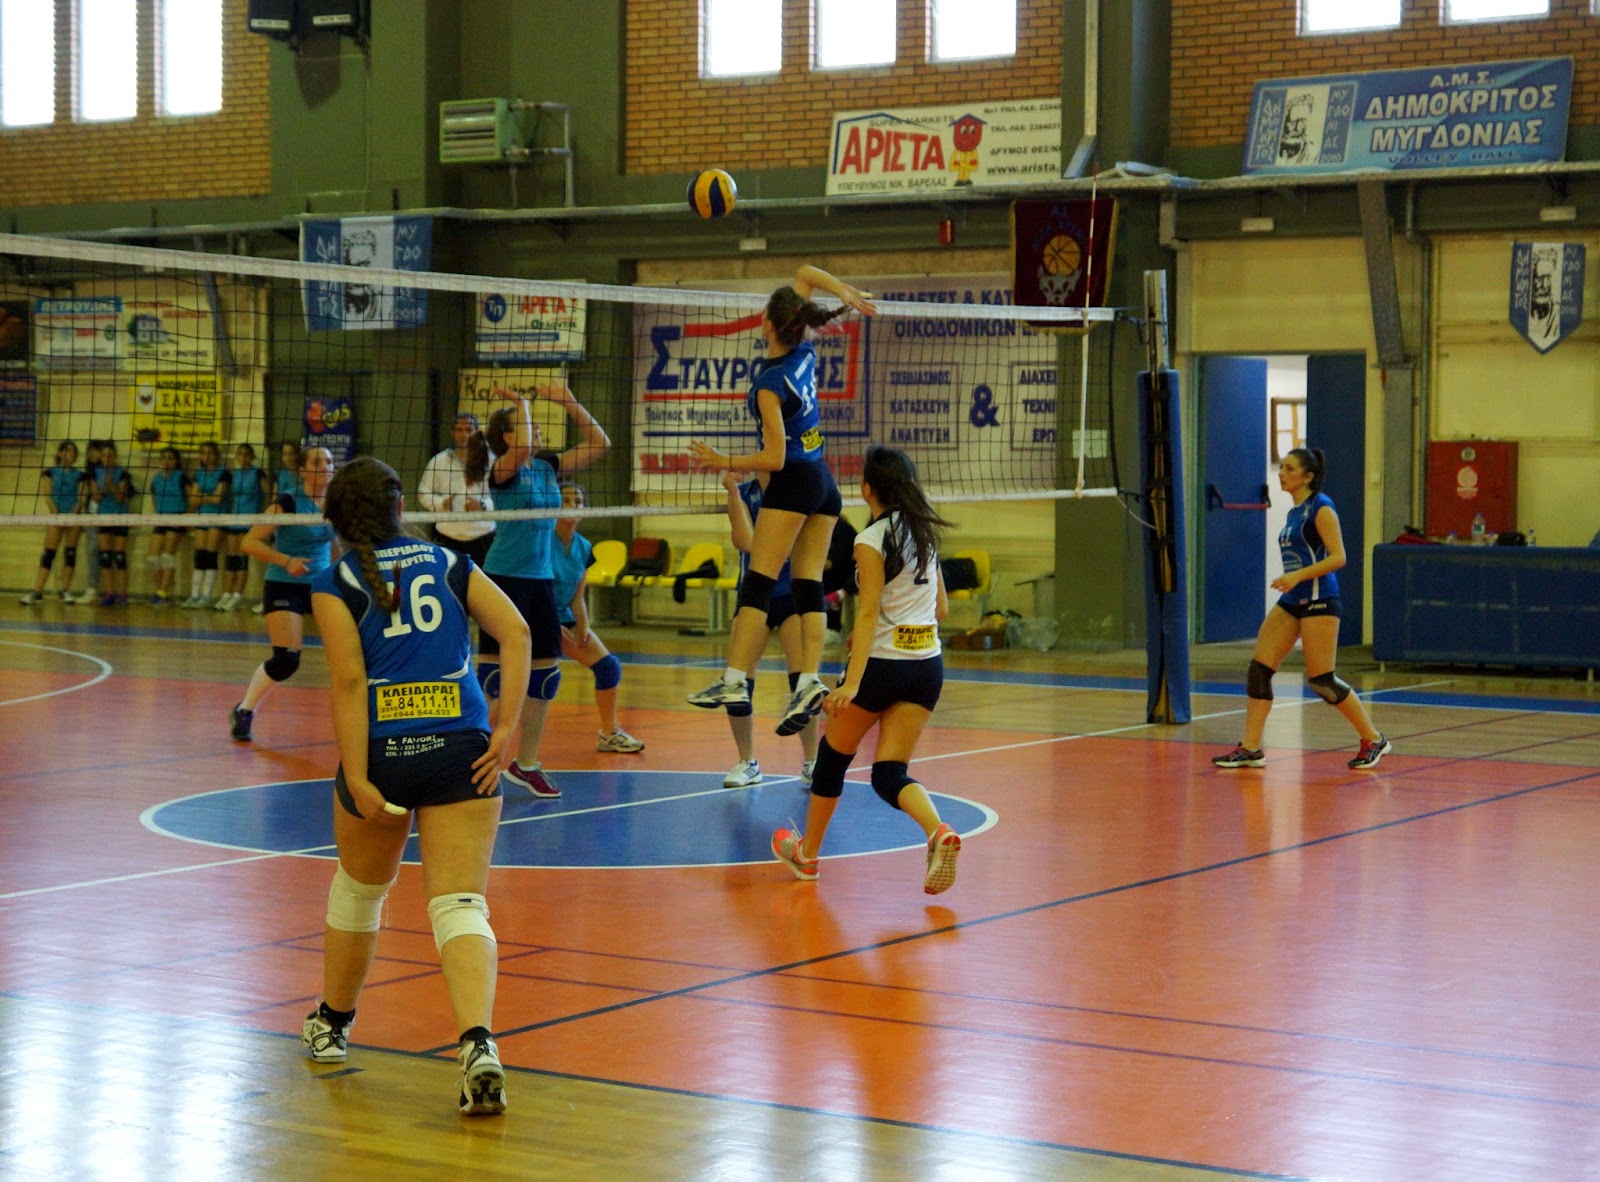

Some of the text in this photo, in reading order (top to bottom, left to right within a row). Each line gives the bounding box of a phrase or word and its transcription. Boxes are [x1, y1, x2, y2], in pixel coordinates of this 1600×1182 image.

[1364, 84, 1558, 120] ΔΗΜΟΚΡΙΤΟΣ
[839, 126, 946, 175] ΑΡΙΣΤΑ
[1370, 119, 1543, 152] ΜΥΓΔΟΝΙΑΣ
[969, 384, 1000, 427] &
[383, 574, 443, 638] 16
[382, 685, 454, 698] ΚΛΕΙΔΑΡΑΣ
[398, 696, 456, 710] 84.11.11
